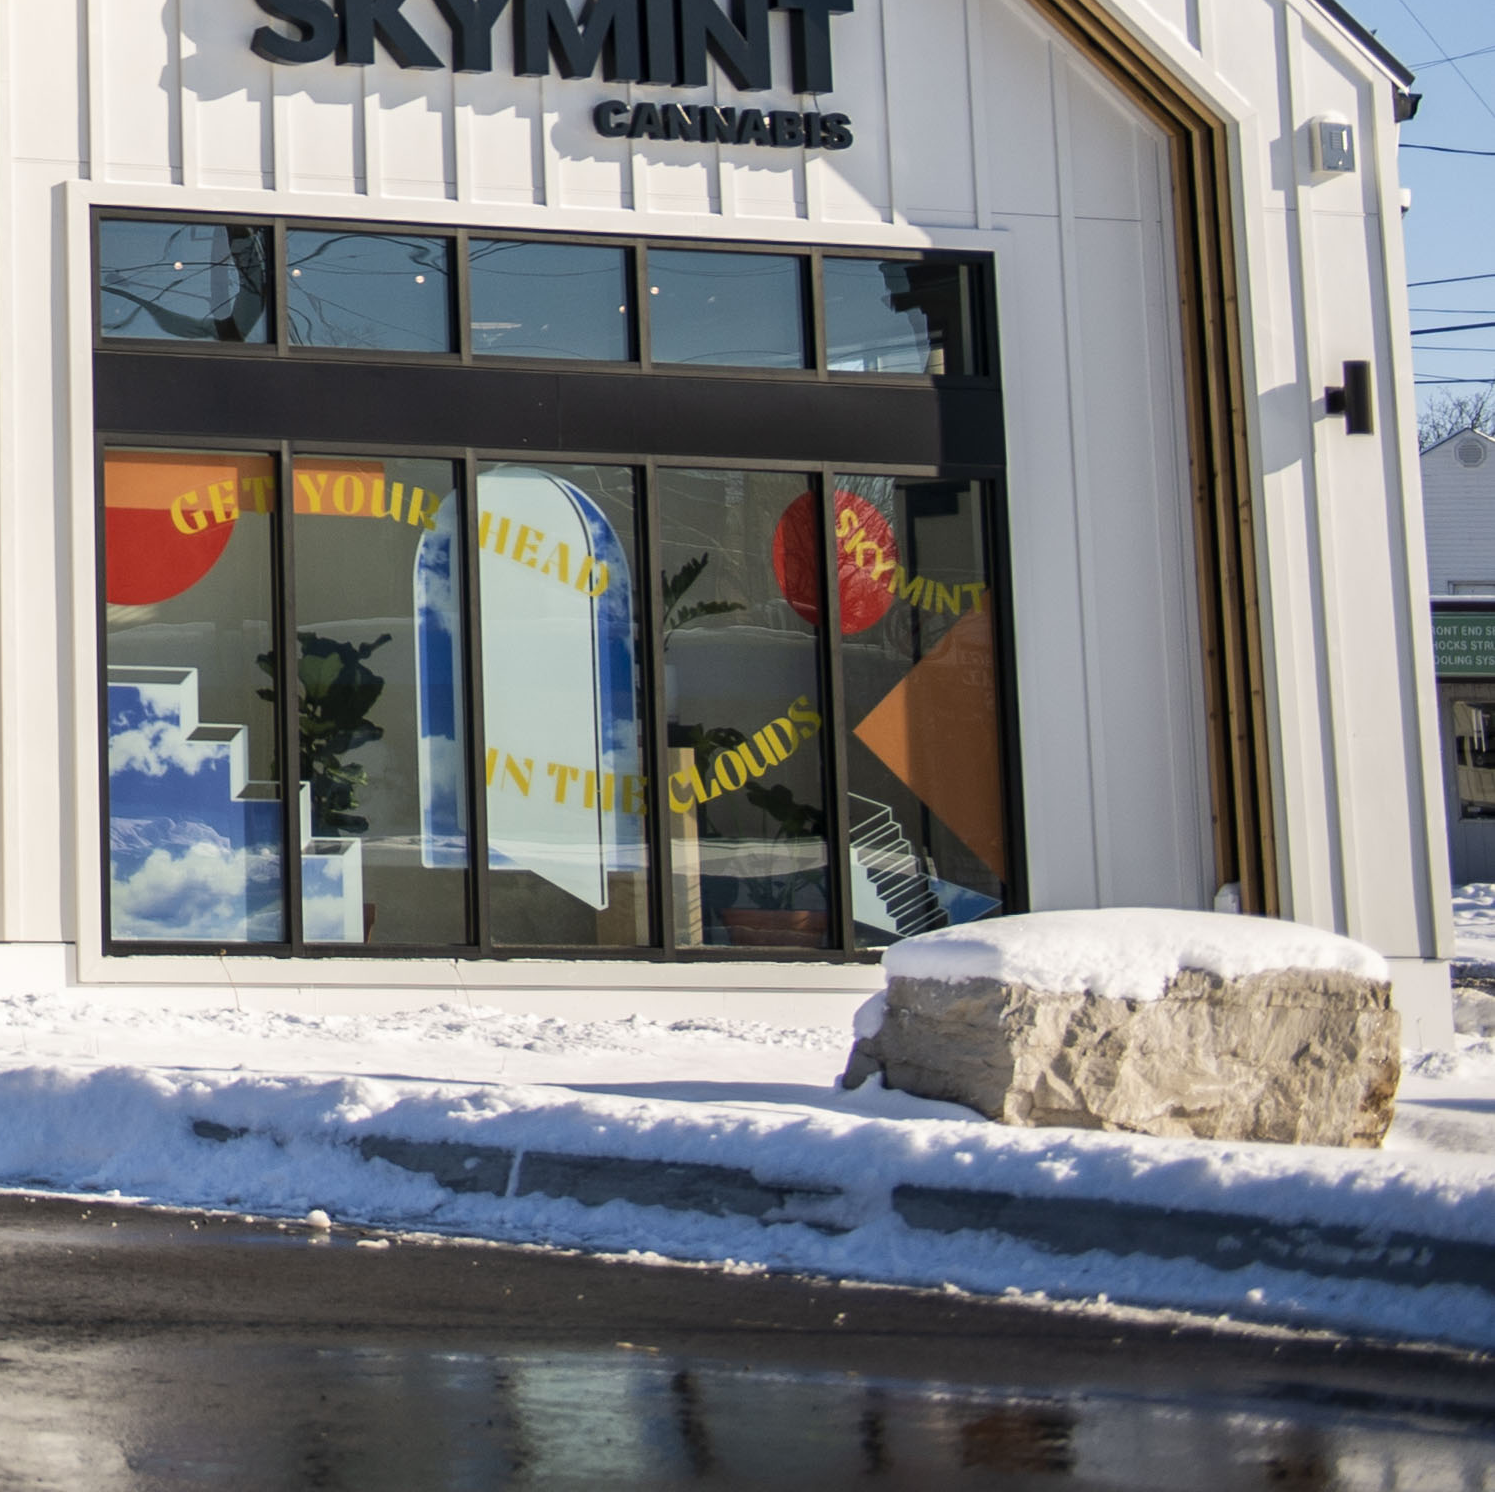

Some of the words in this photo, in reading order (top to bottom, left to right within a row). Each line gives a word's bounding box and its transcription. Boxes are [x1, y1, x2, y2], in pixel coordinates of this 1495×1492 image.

[593, 100, 853, 150] CANNABIS
[170, 475, 275, 535] GET
[297, 473, 441, 532] YOUR
[479, 510, 610, 598] HEAD
[835, 508, 986, 616] SKYMINT
[1433, 625, 1458, 637] ONT
[1461, 625, 1483, 637] END
[485, 747, 534, 797] IN
[547, 761, 648, 816] THE
[667, 694, 823, 814] CLOUDS
